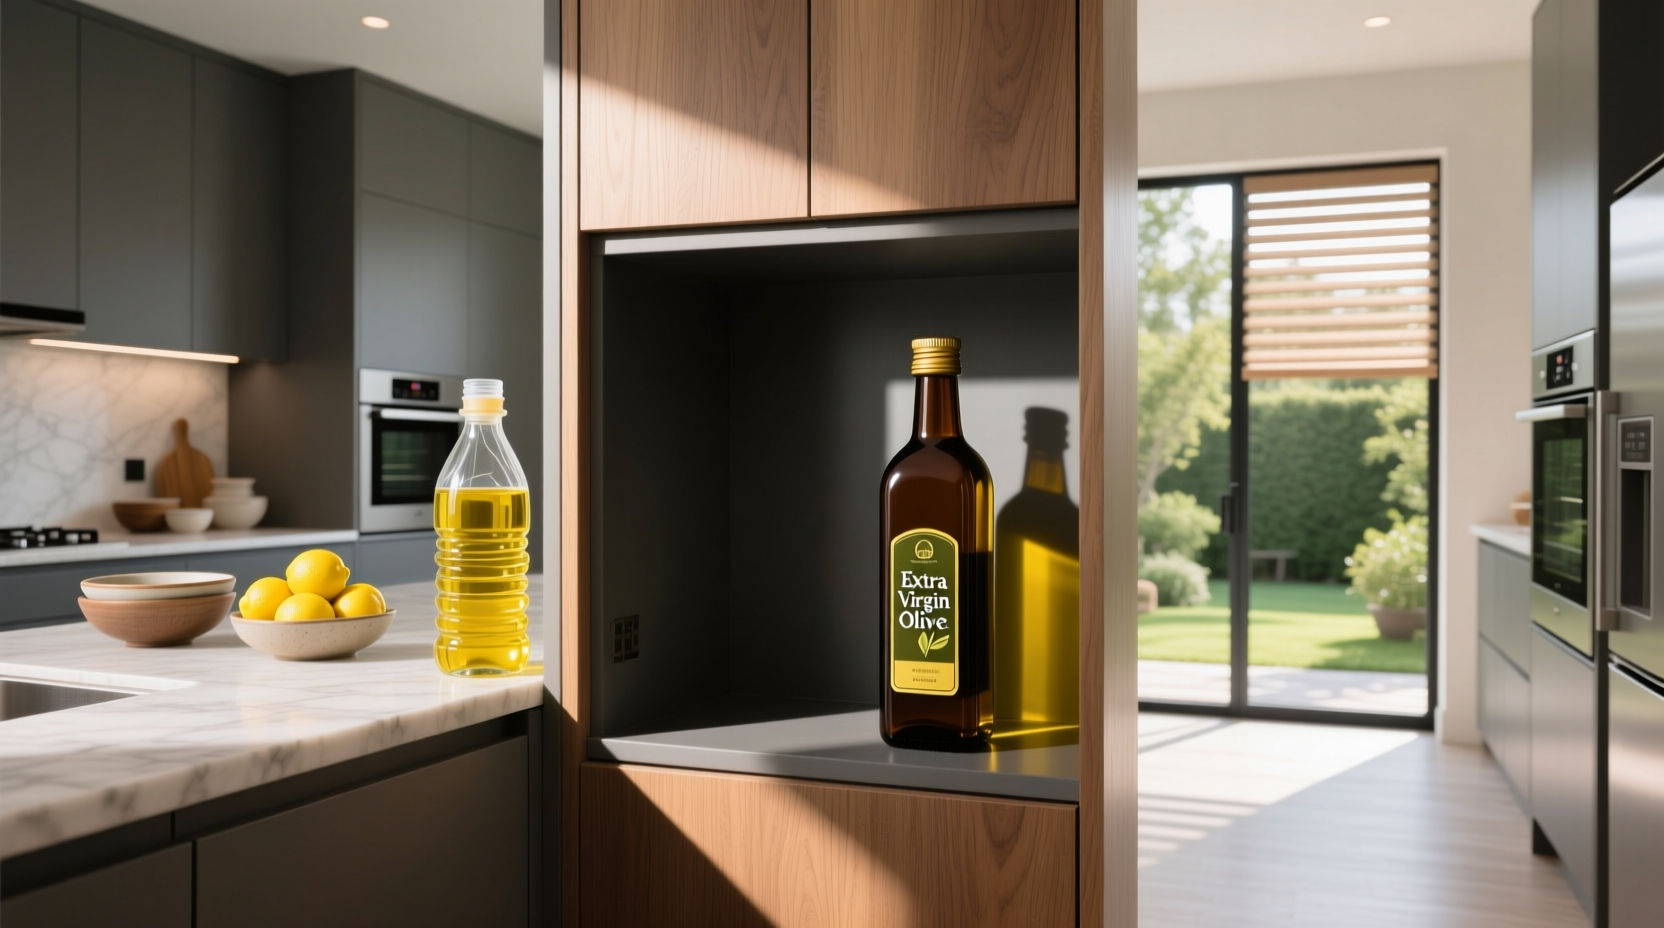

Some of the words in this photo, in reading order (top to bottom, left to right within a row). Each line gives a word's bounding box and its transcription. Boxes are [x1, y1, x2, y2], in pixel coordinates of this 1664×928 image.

[901, 571, 948, 589] Extra
[898, 590, 951, 613] Virgin
[899, 610, 949, 630] Olive
